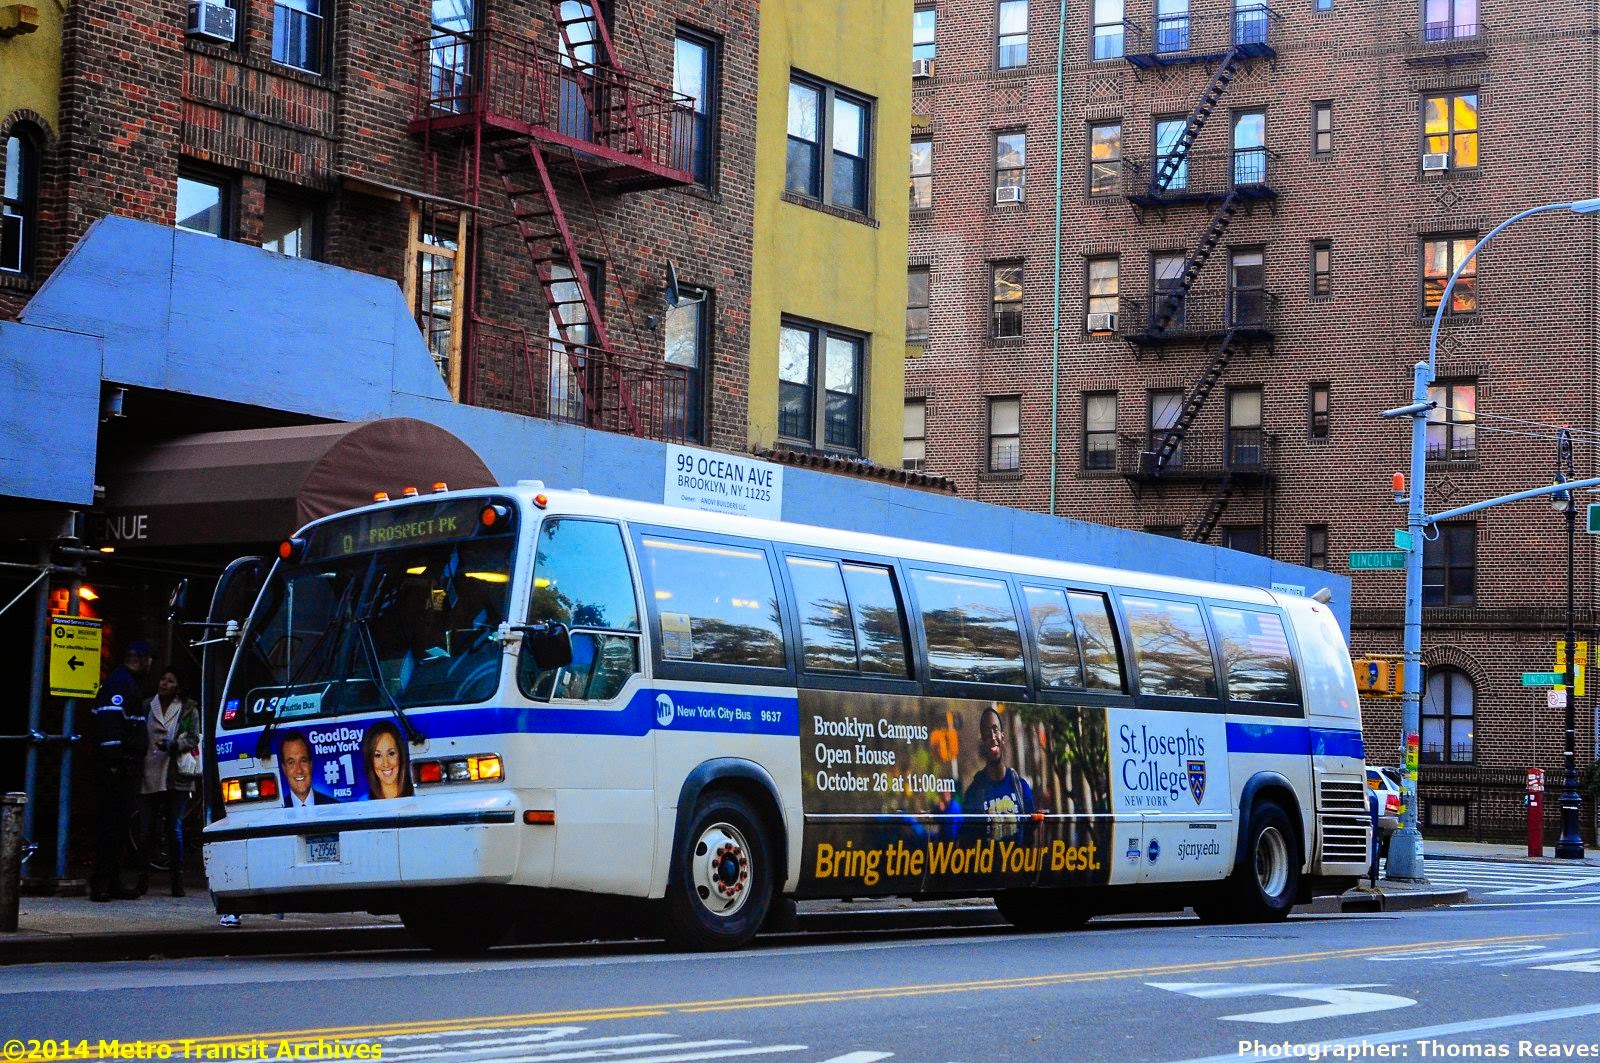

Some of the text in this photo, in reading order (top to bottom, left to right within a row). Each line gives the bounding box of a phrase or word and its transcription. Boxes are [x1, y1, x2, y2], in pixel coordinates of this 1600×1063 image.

[677, 454, 773, 487] 99 OCEAN AVE
[678, 474, 771, 502] BROOKLYN, NY 11225
[717, 500, 738, 509] BUILDERS
[370, 520, 434, 543] PROSPECT
[438, 516, 456, 532] PK
[1351, 554, 1392, 567] LINCOLN
[303, 702, 314, 710] Bus
[656, 698, 673, 720] MTA
[677, 705, 752, 721] New York City Bus
[761, 710, 782, 722] 9637
[814, 716, 928, 744] Brooklyn Campus
[216, 742, 233, 754] 9637
[315, 741, 360, 754] New York
[815, 742, 896, 768] Open House
[1120, 724, 1204, 767] St. Joseph's
[324, 754, 354, 785] #1
[1123, 759, 1187, 801] College
[817, 771, 956, 792] October 26 at 11:00am
[334, 788, 352, 797] FOX5
[1125, 796, 1168, 806] NEW YORK
[1178, 839, 1219, 860] sjcny.edu
[815, 839, 1100, 886] Bring the World Your Best.
